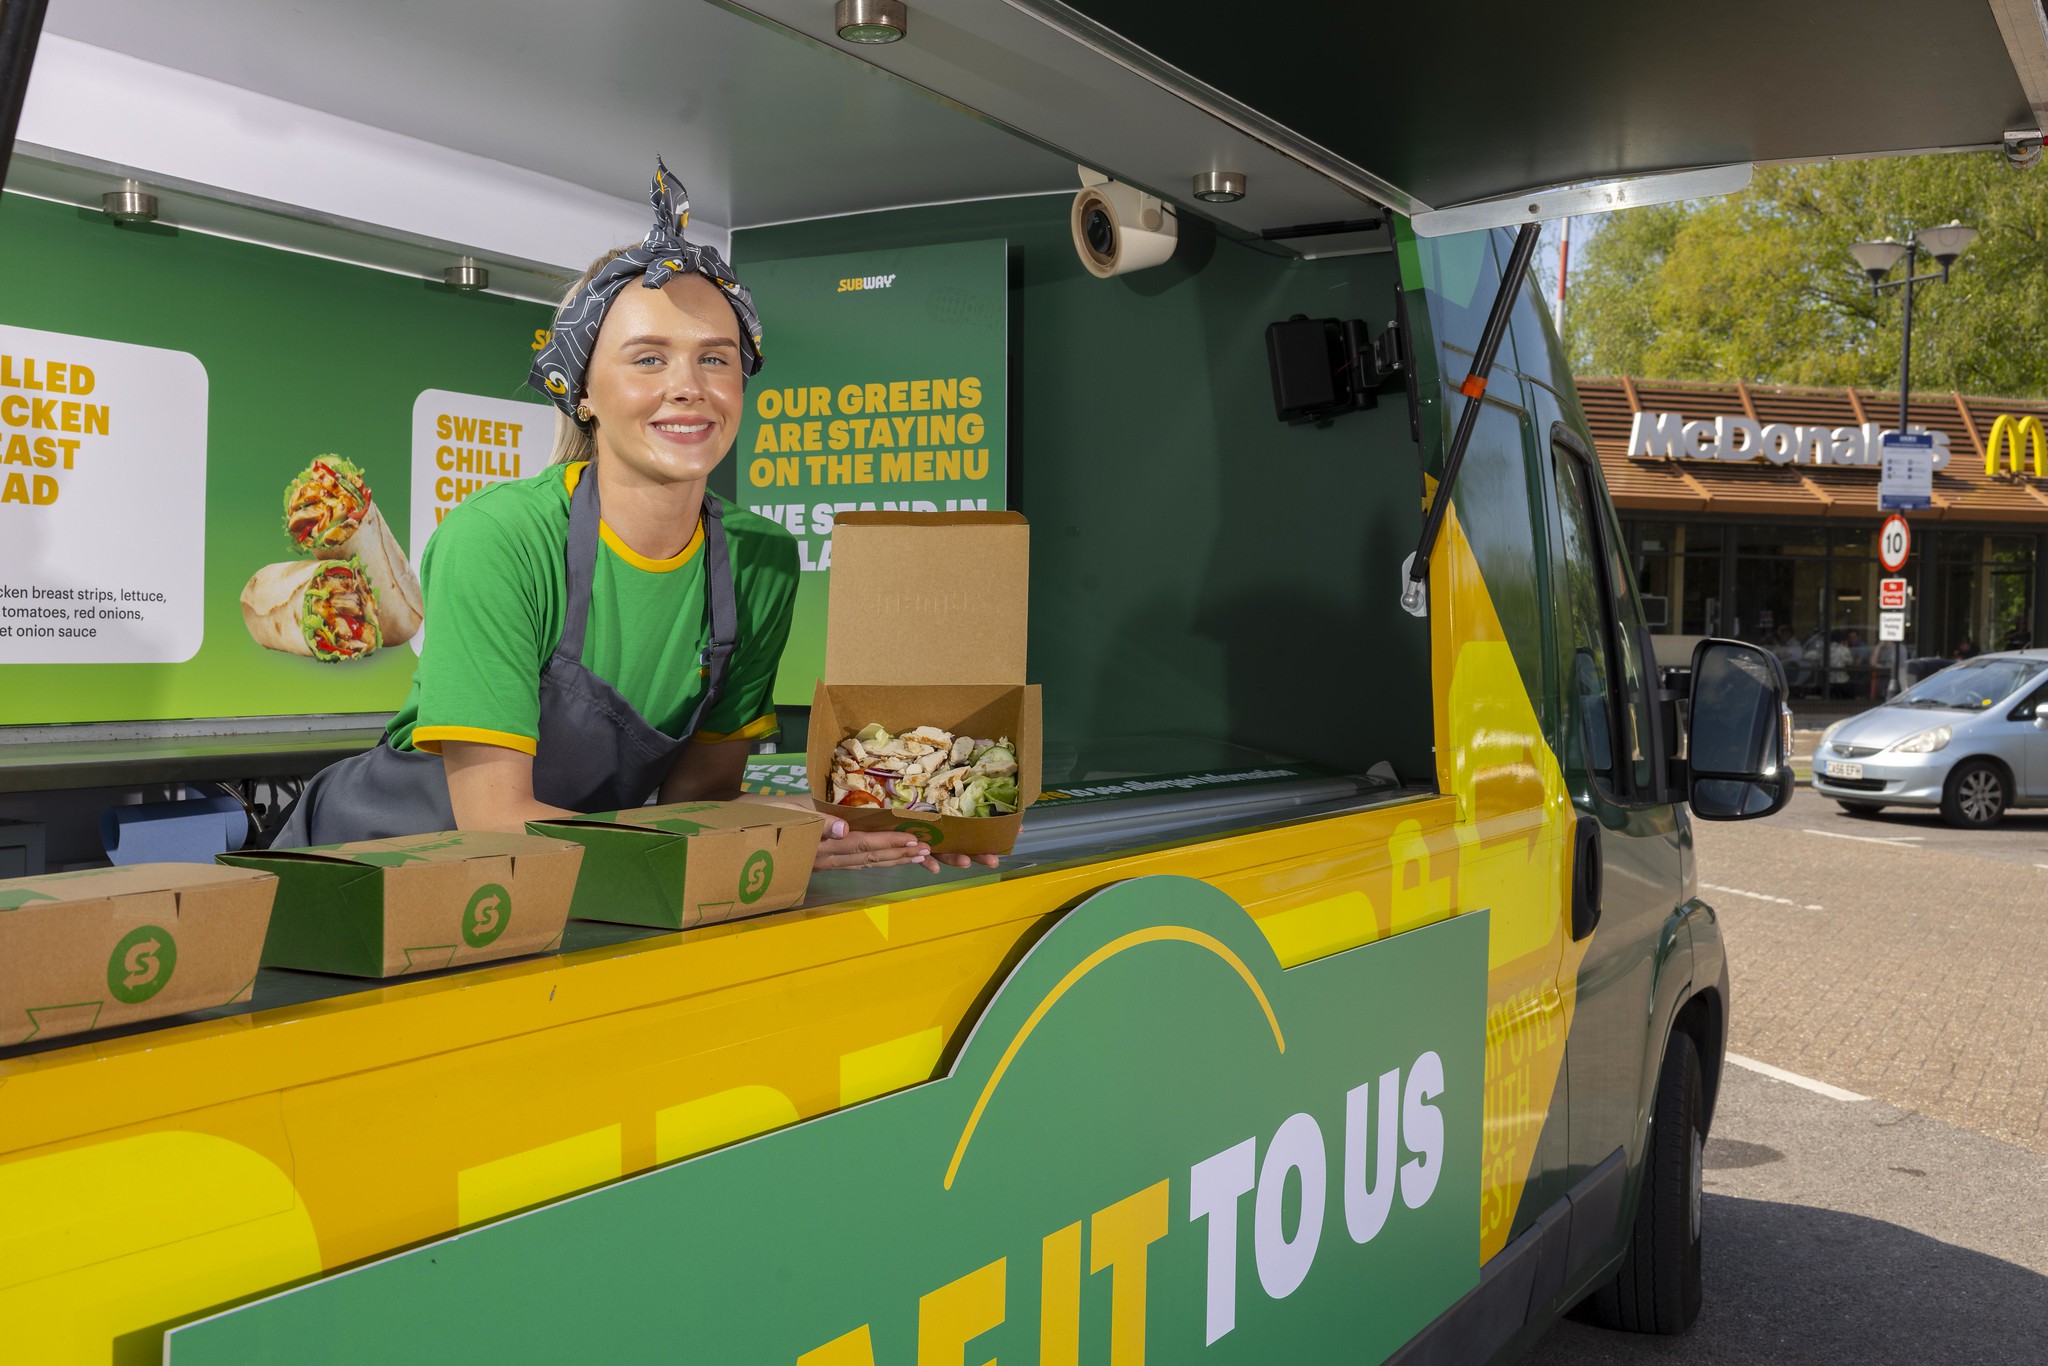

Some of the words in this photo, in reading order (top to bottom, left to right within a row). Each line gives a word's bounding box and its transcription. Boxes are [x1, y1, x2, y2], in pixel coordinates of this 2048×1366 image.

[837, 274, 896, 292] SUBWAY
[757, 386, 832, 419] OUR
[838, 376, 982, 415] GREENS
[436, 413, 523, 448] SWEET
[754, 421, 823, 453] ARE
[828, 413, 985, 450] STAYING
[436, 445, 520, 478] CHILLI
[749, 456, 799, 488] ON
[806, 453, 874, 486] THE
[881, 449, 989, 483] MENU
[1886, 532, 1902, 553] 10
[32, 585, 74, 600] breast
[77, 588, 117, 603] strips,
[120, 588, 167, 603] lettuce,
[2, 606, 70, 620] tomatoes,
[74, 606, 96, 619] red
[98, 607, 144, 621] onions,
[16, 624, 55, 638] onion
[58, 627, 97, 638] sauce
[1190, 1113, 1327, 1347] TO
[1344, 1051, 1445, 1244] US
